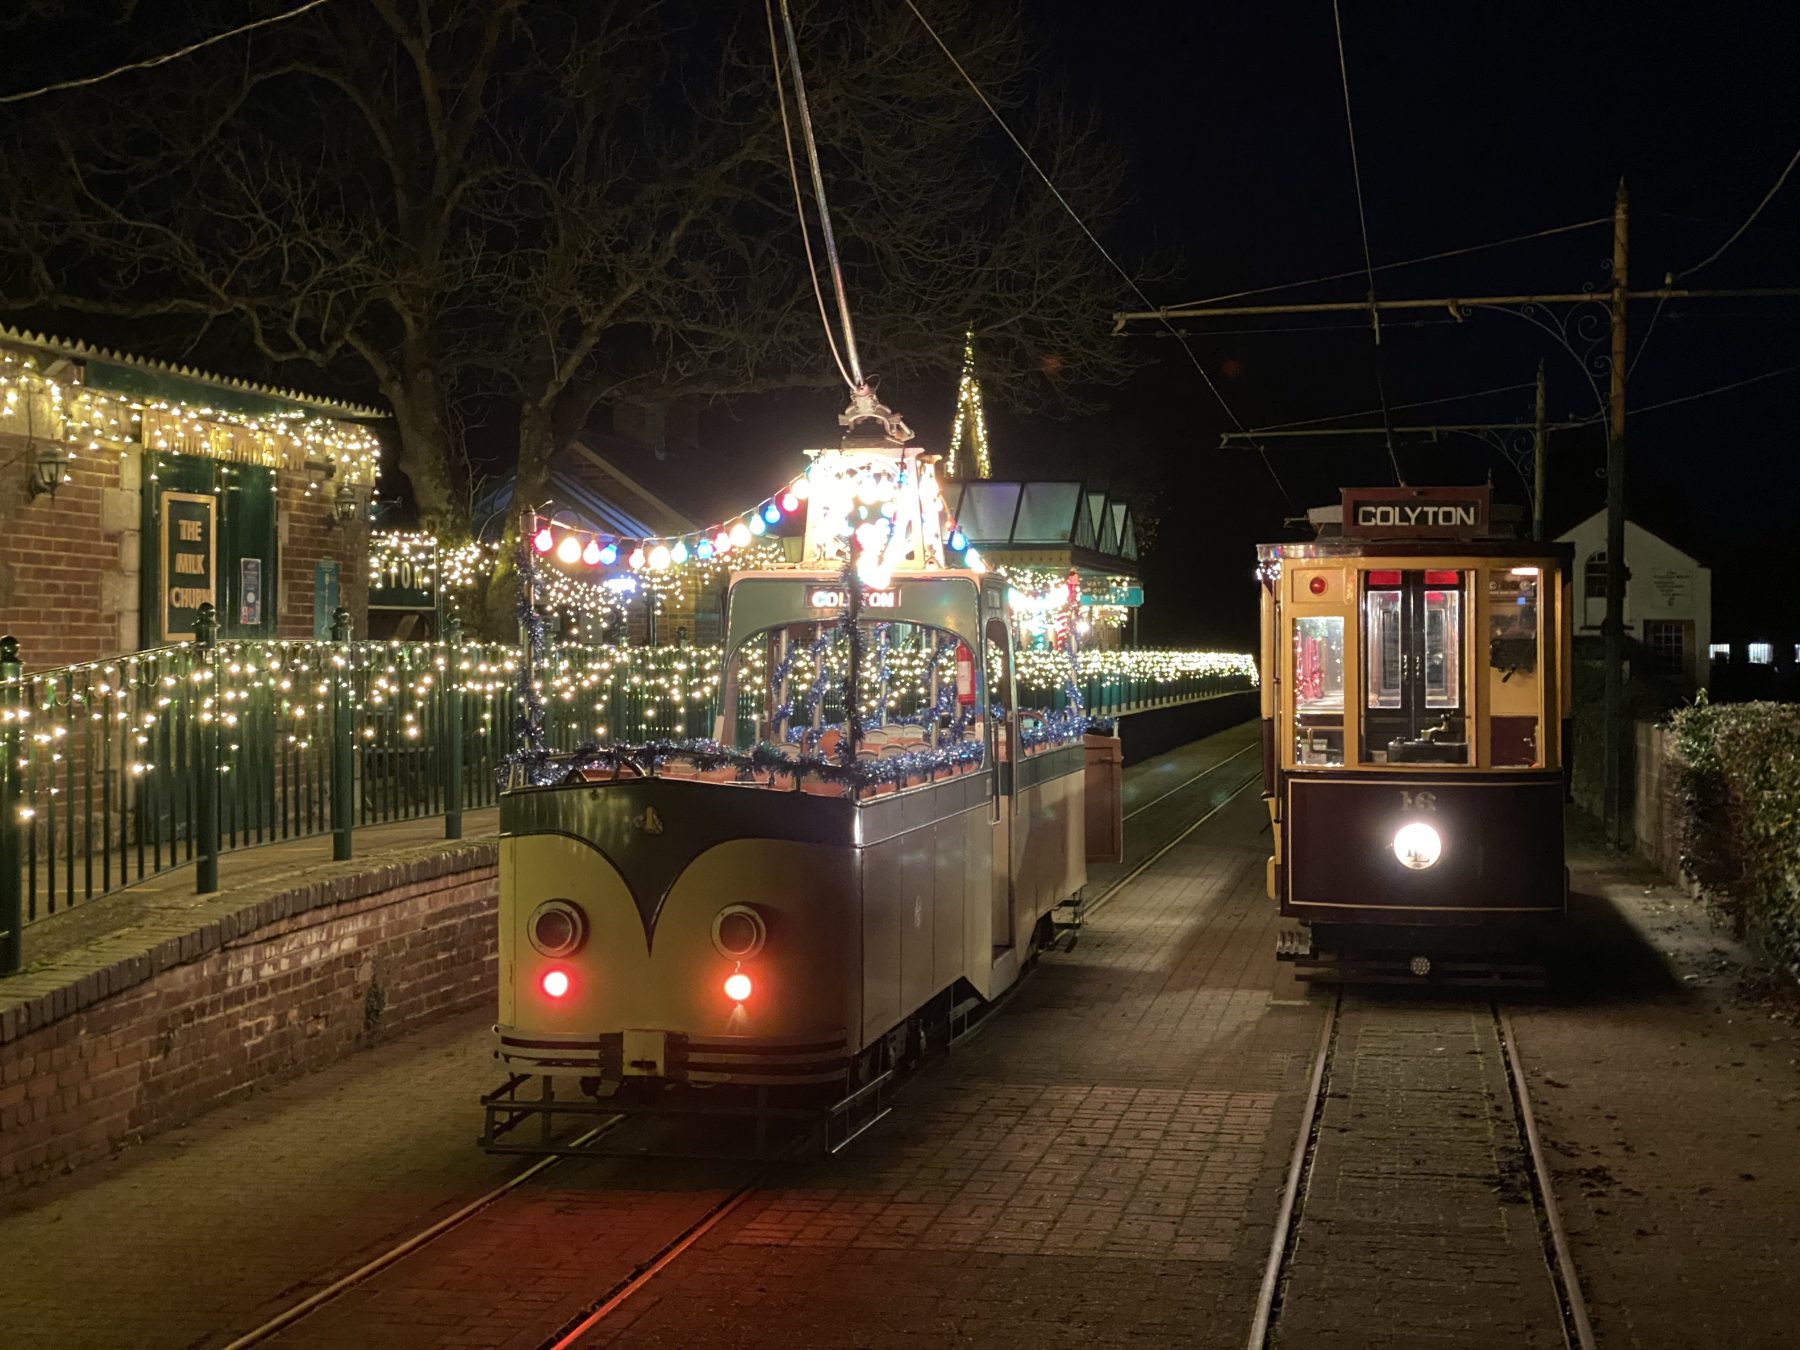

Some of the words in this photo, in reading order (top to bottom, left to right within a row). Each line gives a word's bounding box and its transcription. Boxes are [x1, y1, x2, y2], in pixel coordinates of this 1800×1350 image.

[1358, 506, 1475, 526] COLYTON
[179, 519, 202, 541] THE
[175, 552, 205, 574] MILK
[1400, 790, 1437, 811] 16
